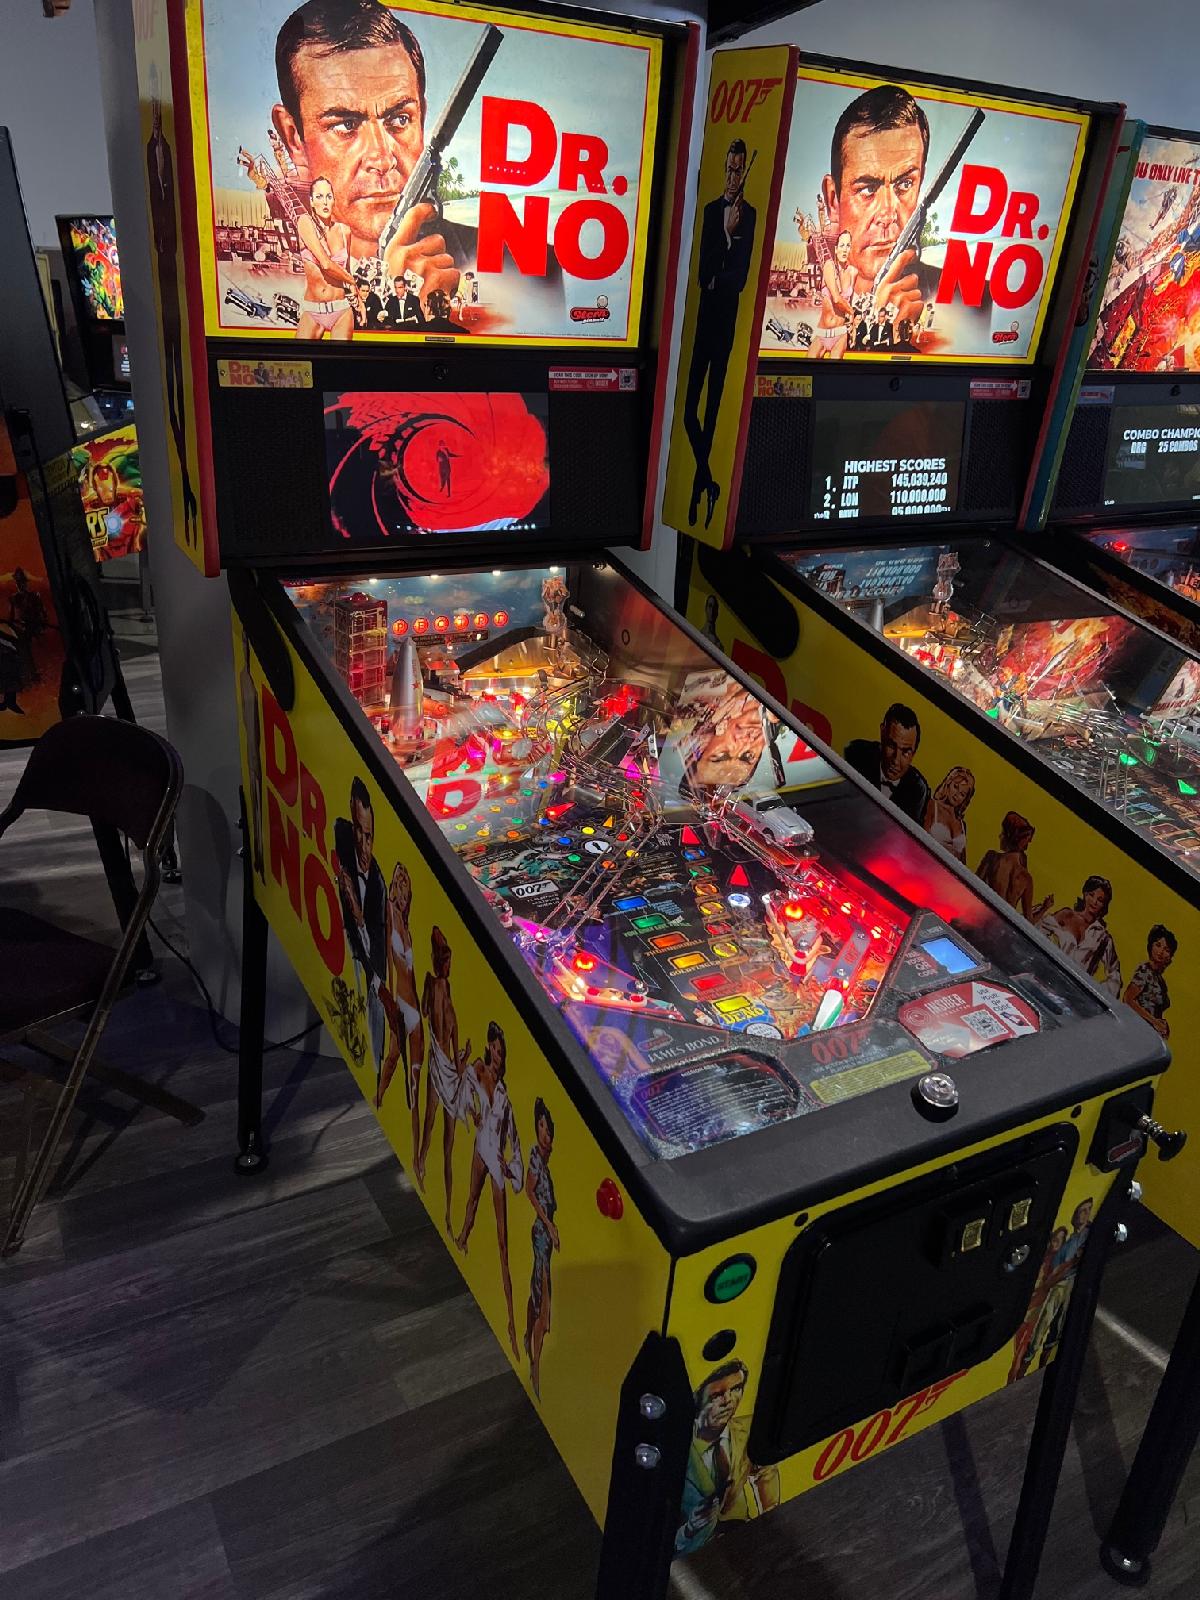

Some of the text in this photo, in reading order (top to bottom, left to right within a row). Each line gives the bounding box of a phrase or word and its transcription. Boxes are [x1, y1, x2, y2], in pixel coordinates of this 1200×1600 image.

[710, 77, 783, 123] 007
[481, 96, 628, 195] DR.
[1149, 164, 1174, 181] ONLY
[951, 164, 1050, 240] DR.
[477, 191, 629, 281] NO
[935, 238, 1044, 309] NO
[1123, 429, 1159, 440] COMBO
[1158, 440, 1198, 453] 25 COMBOS
[844, 458, 946, 473] HIGHEST SCORES
[267, 784, 345, 977] NO
[516, 881, 552, 896] 007
[924, 993, 967, 1015] INSIDER
[648, 1044, 686, 1063] JAMES
[685, 1035, 720, 1052] BOND
[811, 1028, 871, 1065] 007
[813, 1369, 968, 1481] 007
